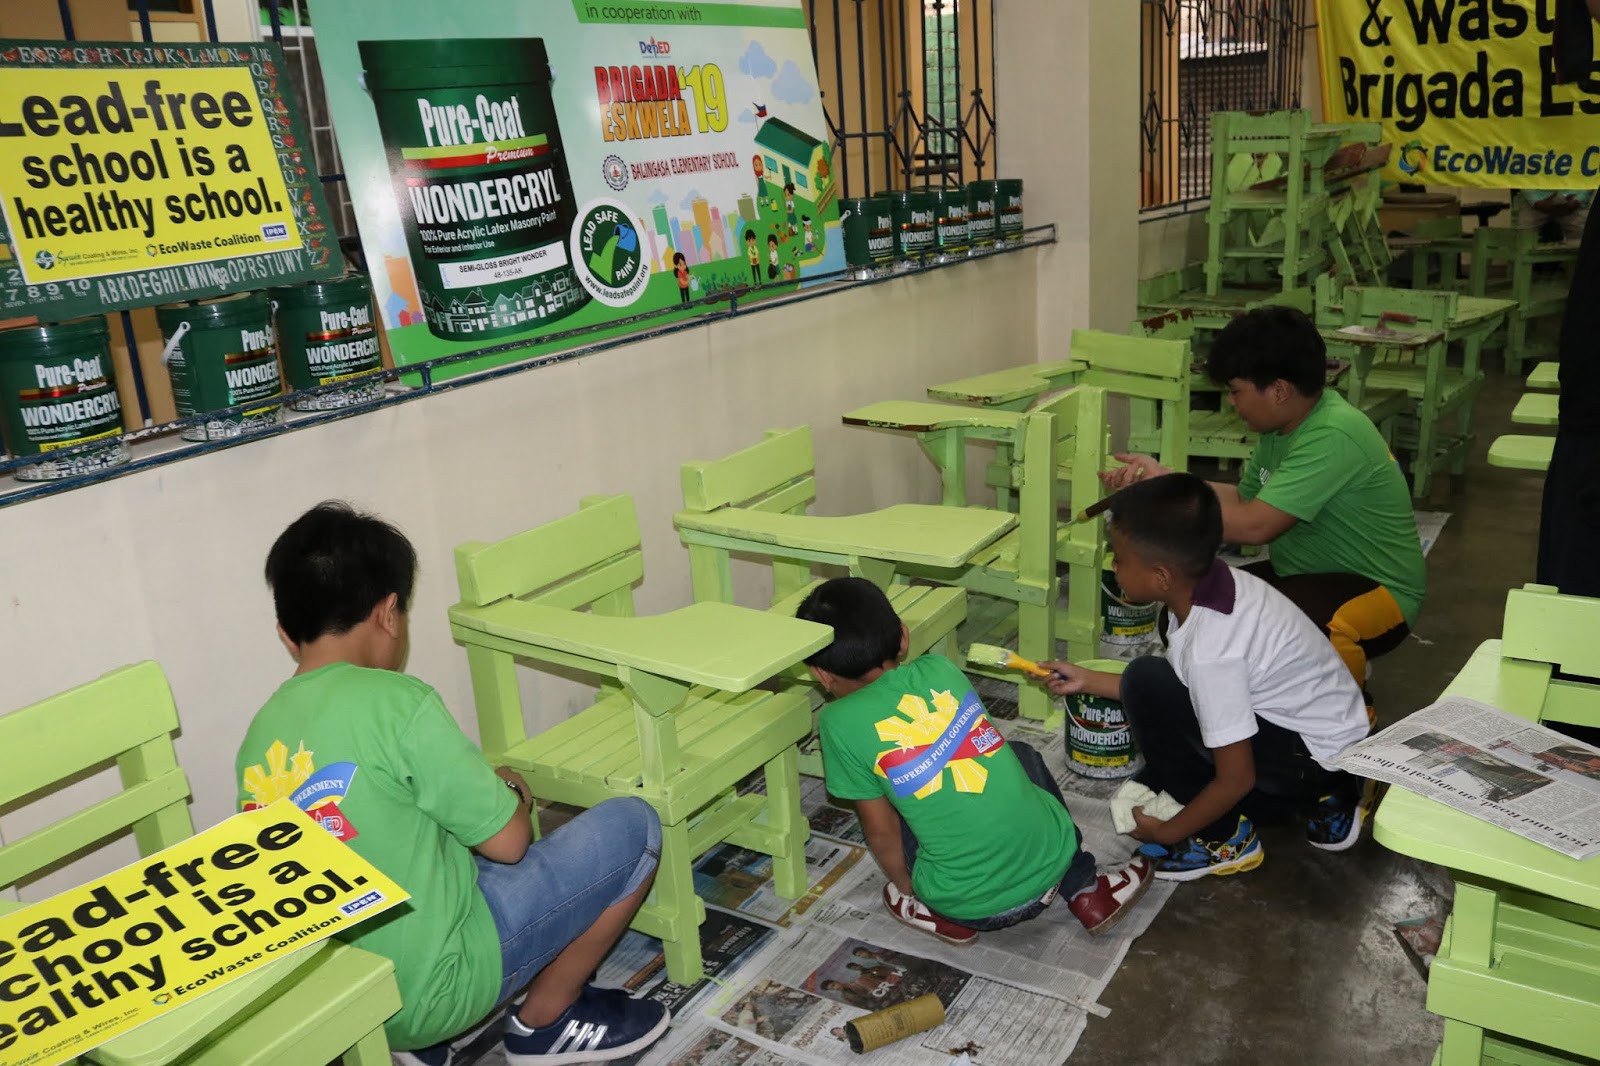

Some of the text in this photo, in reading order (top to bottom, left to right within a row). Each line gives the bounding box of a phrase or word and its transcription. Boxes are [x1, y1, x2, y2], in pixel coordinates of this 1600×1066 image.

[585, 3, 701, 23] in cooperation with
[1404, 0, 1556, 45] Wast
[164, 47, 178, 63] K
[186, 47, 199, 62] L
[257, 80, 268, 94] P
[594, 65, 682, 104] BRIGADA
[1339, 51, 1523, 132] Brigada
[261, 98, 275, 114] Q
[267, 117, 281, 131] R
[417, 94, 526, 147] Pure-Coat
[600, 98, 692, 142] ESKWELA
[272, 134, 284, 148] S
[23, 137, 251, 189] school is a
[485, 145, 535, 164] Premium
[630, 160, 671, 180] BALINGASA
[671, 154, 711, 175] ELEMENTARY
[713, 151, 739, 169] SCHOOL
[1433, 145, 1572, 177] EcoWaste
[14, 177, 283, 238] healthy school.
[407, 167, 561, 225] WONDERCRYL
[419, 210, 557, 242] 100% Pure Acrylic Latex Masonry Paint
[583, 220, 596, 251] LEAD
[594, 210, 619, 225] SAFE
[158, 239, 213, 255] EcoWaste
[214, 233, 261, 248] Coalition
[484, 240, 495, 248] Use
[459, 250, 547, 273] SEMI-GLOSS BRIGHT WONDER
[494, 267, 523, 279] 48-135-AK
[615, 256, 635, 281] PAINT
[6, 268, 21, 281] 2
[585, 264, 649, 299] www.leadsafepaint.org
[5, 278, 91, 301] 7 8 9 10
[320, 305, 370, 331] Pure-Coat
[35, 355, 104, 389] Pure-Coat
[892, 702, 982, 785] SUPREME PUPIL GOVERNMENT
[970, 727, 1002, 754] DepE
[1373, 757, 1395, 768] the
[1396, 764, 1410, 773] to
[293, 780, 344, 805] OVERNMENT
[1410, 770, 1457, 792] appeal
[1458, 790, 1478, 801] an
[1521, 818, 1554, 832] and
[1554, 832, 1588, 847] Belt
[191, 882, 256, 916] is
[268, 860, 311, 885] a
[181, 869, 369, 962] school.
[174, 951, 263, 996] EcoWaste
[264, 914, 343, 954] Coalition
[42, 1033, 81, 1054] Coating
